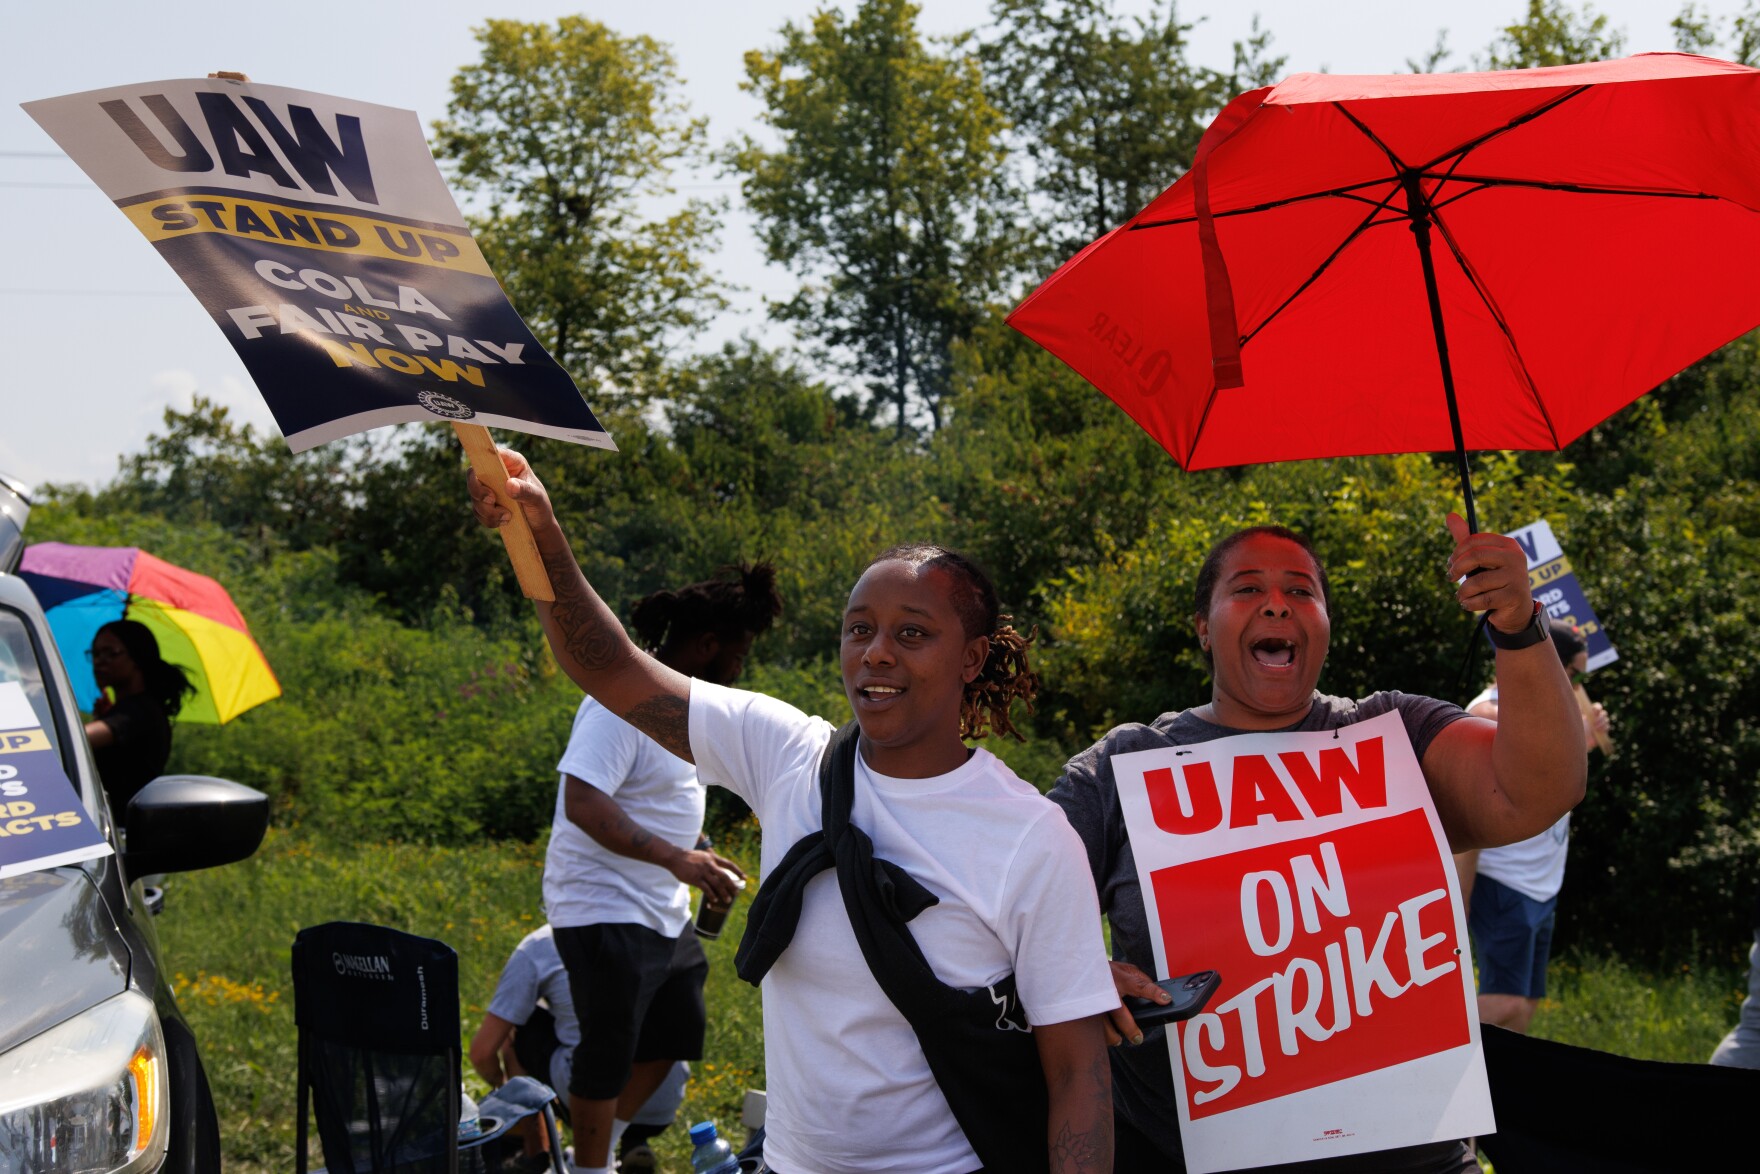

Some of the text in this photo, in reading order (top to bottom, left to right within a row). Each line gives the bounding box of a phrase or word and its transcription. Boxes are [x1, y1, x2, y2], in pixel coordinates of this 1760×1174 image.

[98, 91, 379, 205] UAW
[151, 200, 461, 262] STAND UP
[254, 259, 453, 321] COLA
[344, 303, 390, 321] AND
[226, 304, 526, 365] FAIR PAY
[319, 340, 486, 388] NOW
[1538, 563, 1562, 581] UP
[1142, 736, 1388, 836] UAW
[1240, 842, 1351, 957] ON
[343, 953, 390, 973] MAGELLAN
[1183, 888, 1457, 1106] STRIKE
